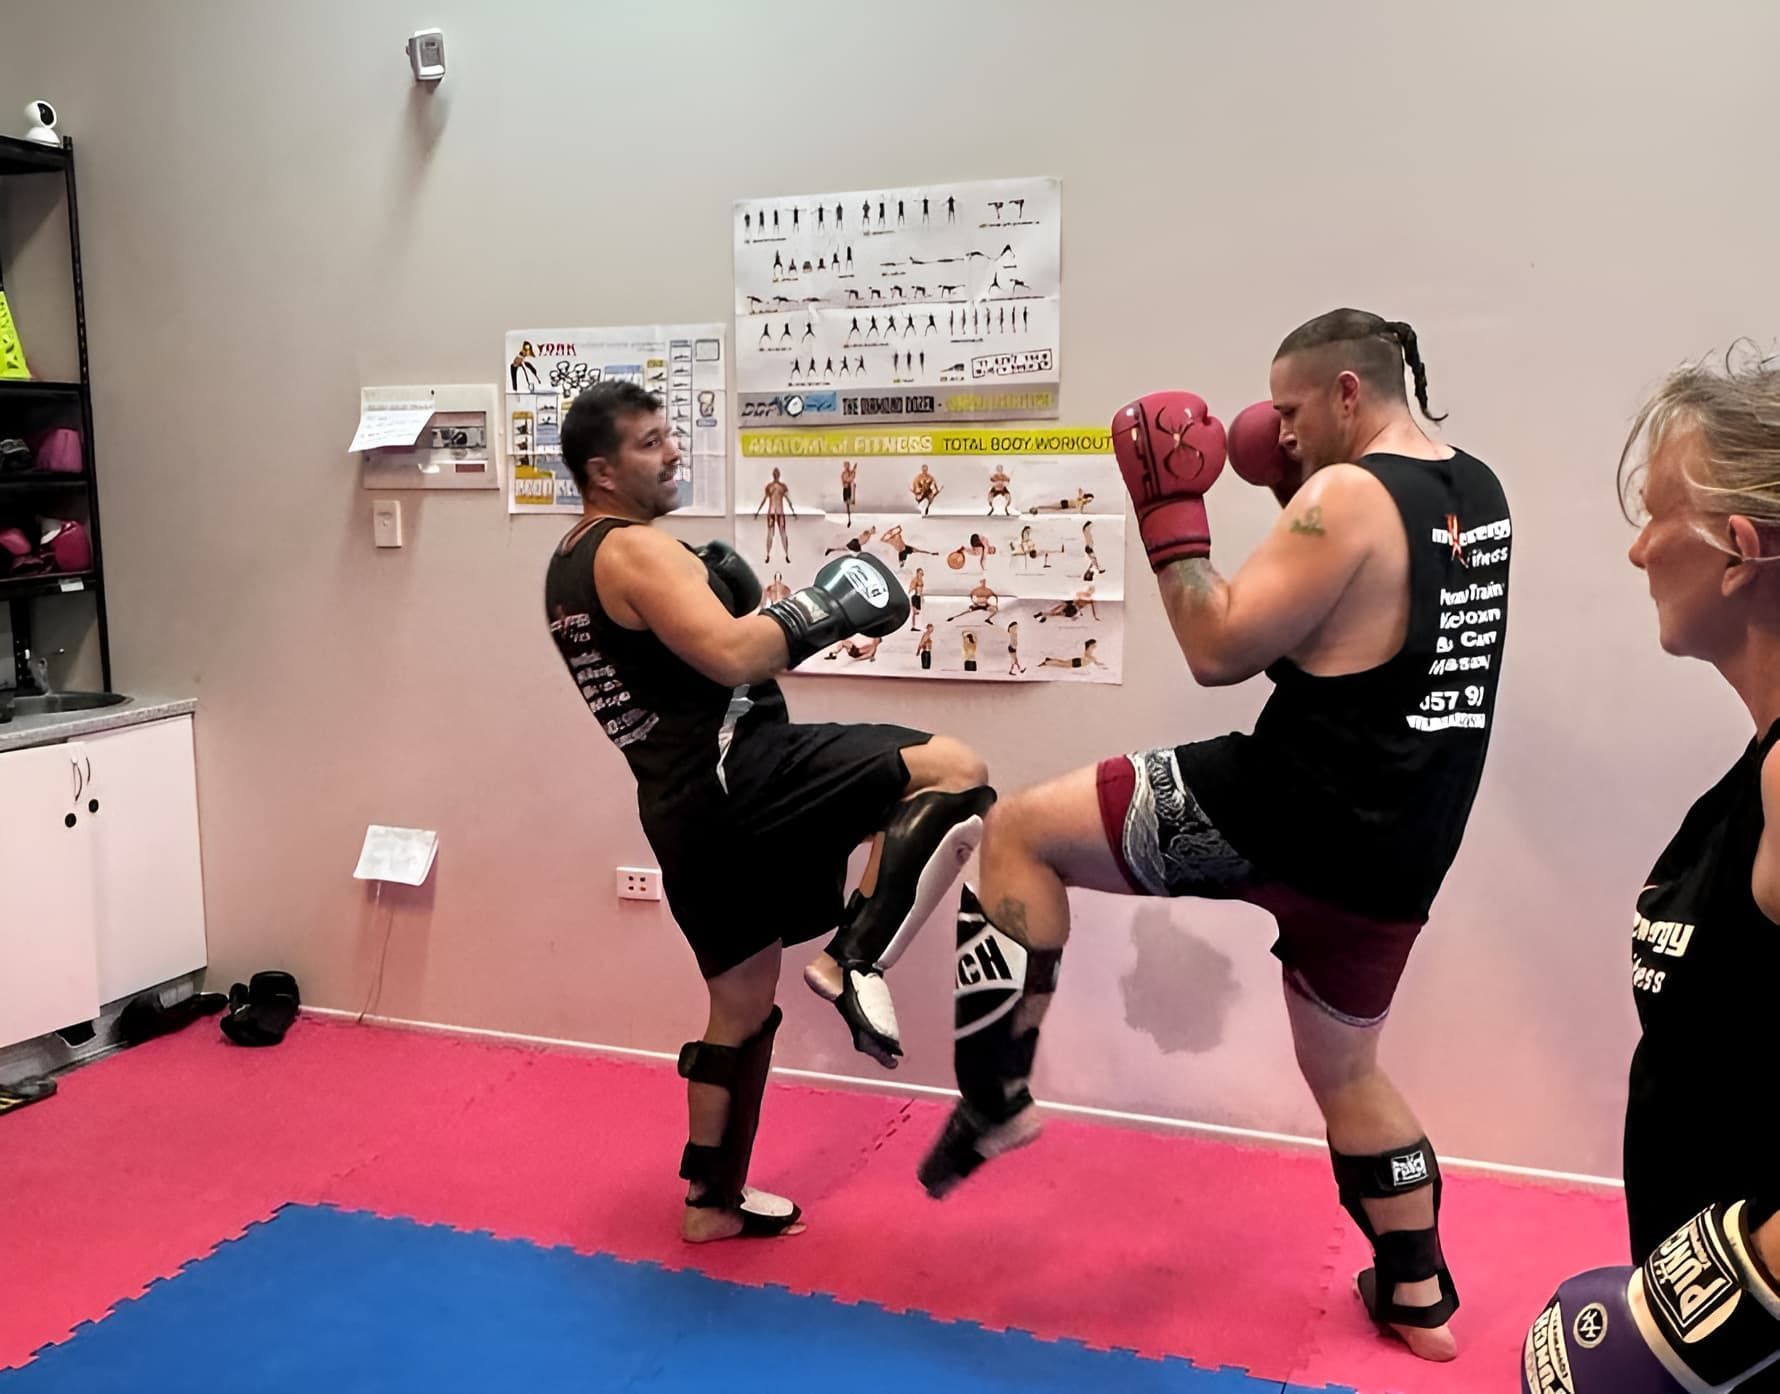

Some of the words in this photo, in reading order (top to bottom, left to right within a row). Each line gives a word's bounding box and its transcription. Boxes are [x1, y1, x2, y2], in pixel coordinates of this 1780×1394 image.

[749, 437, 822, 455] ANATOMY
[854, 434, 932, 453] FITNESS
[943, 437, 986, 451] TOTAL
[991, 436, 1033, 451] BODY
[1035, 435, 1113, 450] WORKOUT
